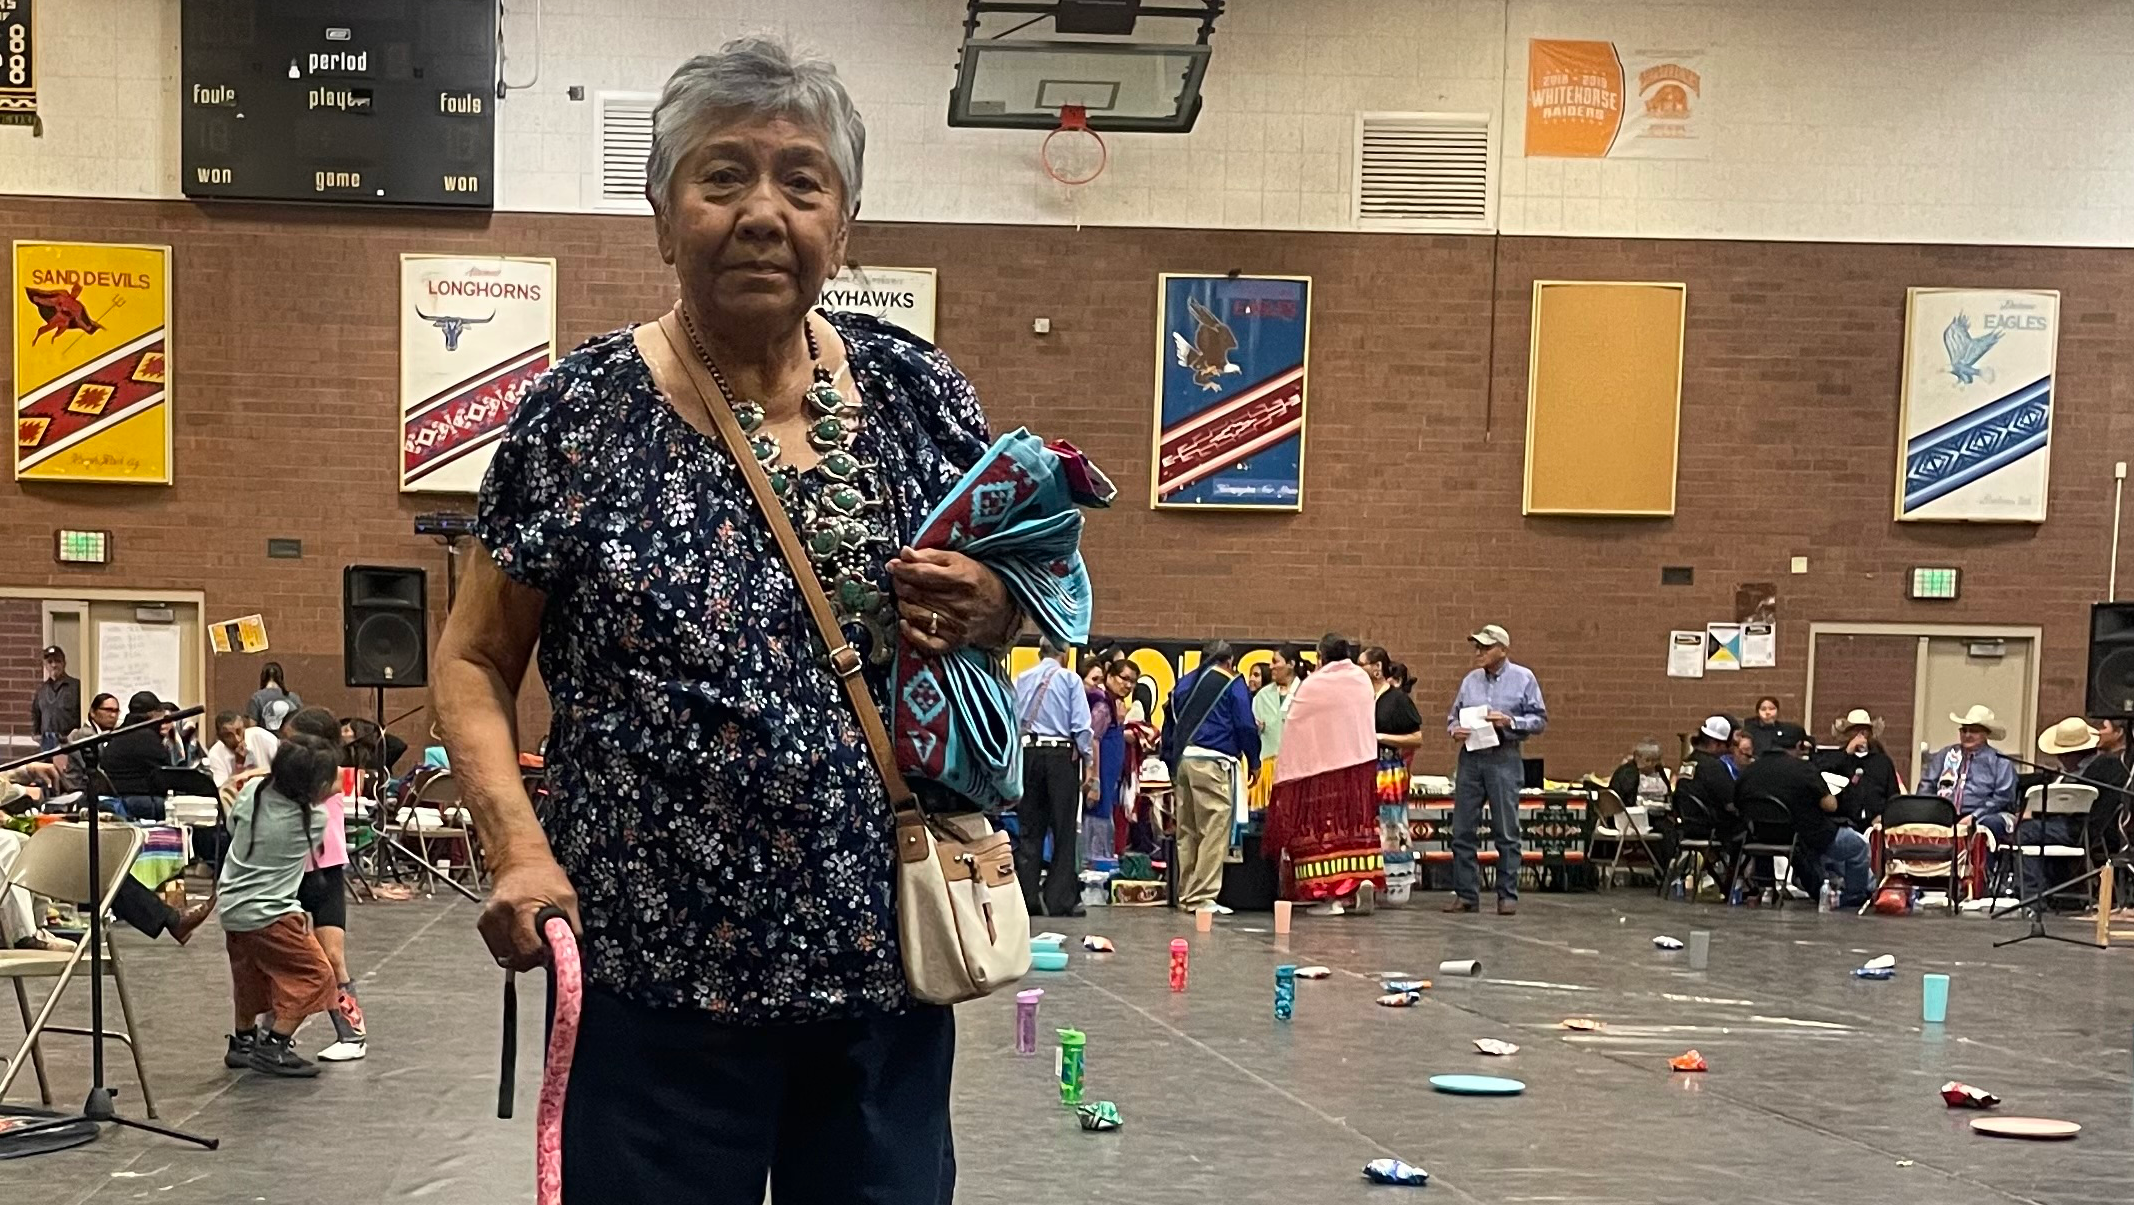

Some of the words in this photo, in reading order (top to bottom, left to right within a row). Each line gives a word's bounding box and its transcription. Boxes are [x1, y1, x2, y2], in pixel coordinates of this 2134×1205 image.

[309, 51, 367, 74] period
[440, 93, 482, 114] fouls
[1531, 85, 1617, 111] WHITEHORSE
[1543, 106, 1604, 120] RAIDERS
[197, 167, 232, 184] won
[315, 171, 361, 192] game
[444, 175, 478, 192] won
[32, 269, 80, 286] SAND
[83, 270, 150, 290] DEVILS
[428, 280, 541, 301] LONGHORNS
[821, 289, 914, 309] KYHAWKS
[1983, 314, 2047, 331] EAGLES
